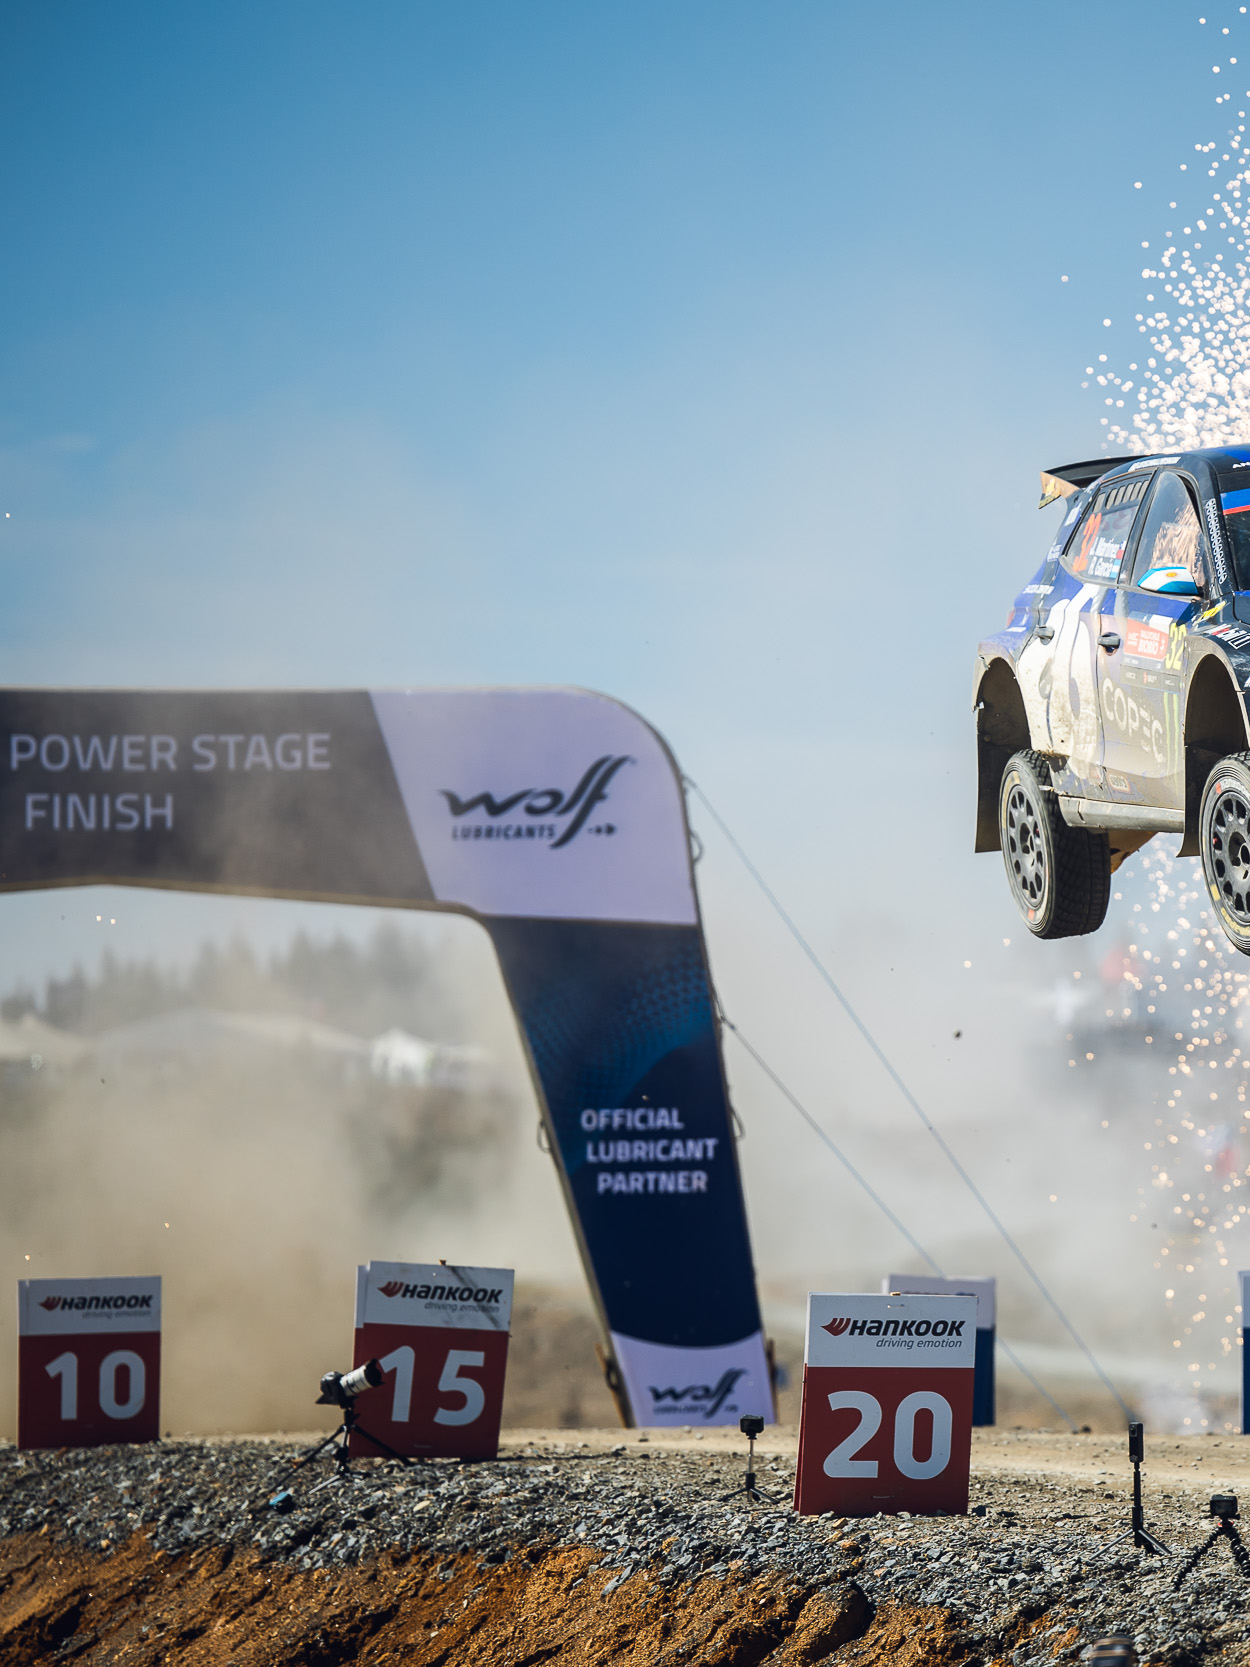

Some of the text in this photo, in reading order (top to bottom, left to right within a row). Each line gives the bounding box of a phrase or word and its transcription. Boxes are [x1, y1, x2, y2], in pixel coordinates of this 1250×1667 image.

[1073, 512, 1102, 572] 32
[1165, 622, 1187, 670] 32
[9, 732, 332, 771] POWER STAGE
[24, 792, 174, 831] FINISH
[451, 824, 556, 842] LUBRICANTS
[580, 1107, 685, 1132] OFFICIAL
[586, 1137, 719, 1163] LUBRICANT
[597, 1170, 709, 1194] PARTNER
[424, 1301, 500, 1313] driving emotion
[876, 1337, 962, 1350] driving emotion
[44, 1349, 146, 1420] 10
[378, 1345, 485, 1427] 15
[823, 1390, 953, 1480] 20
